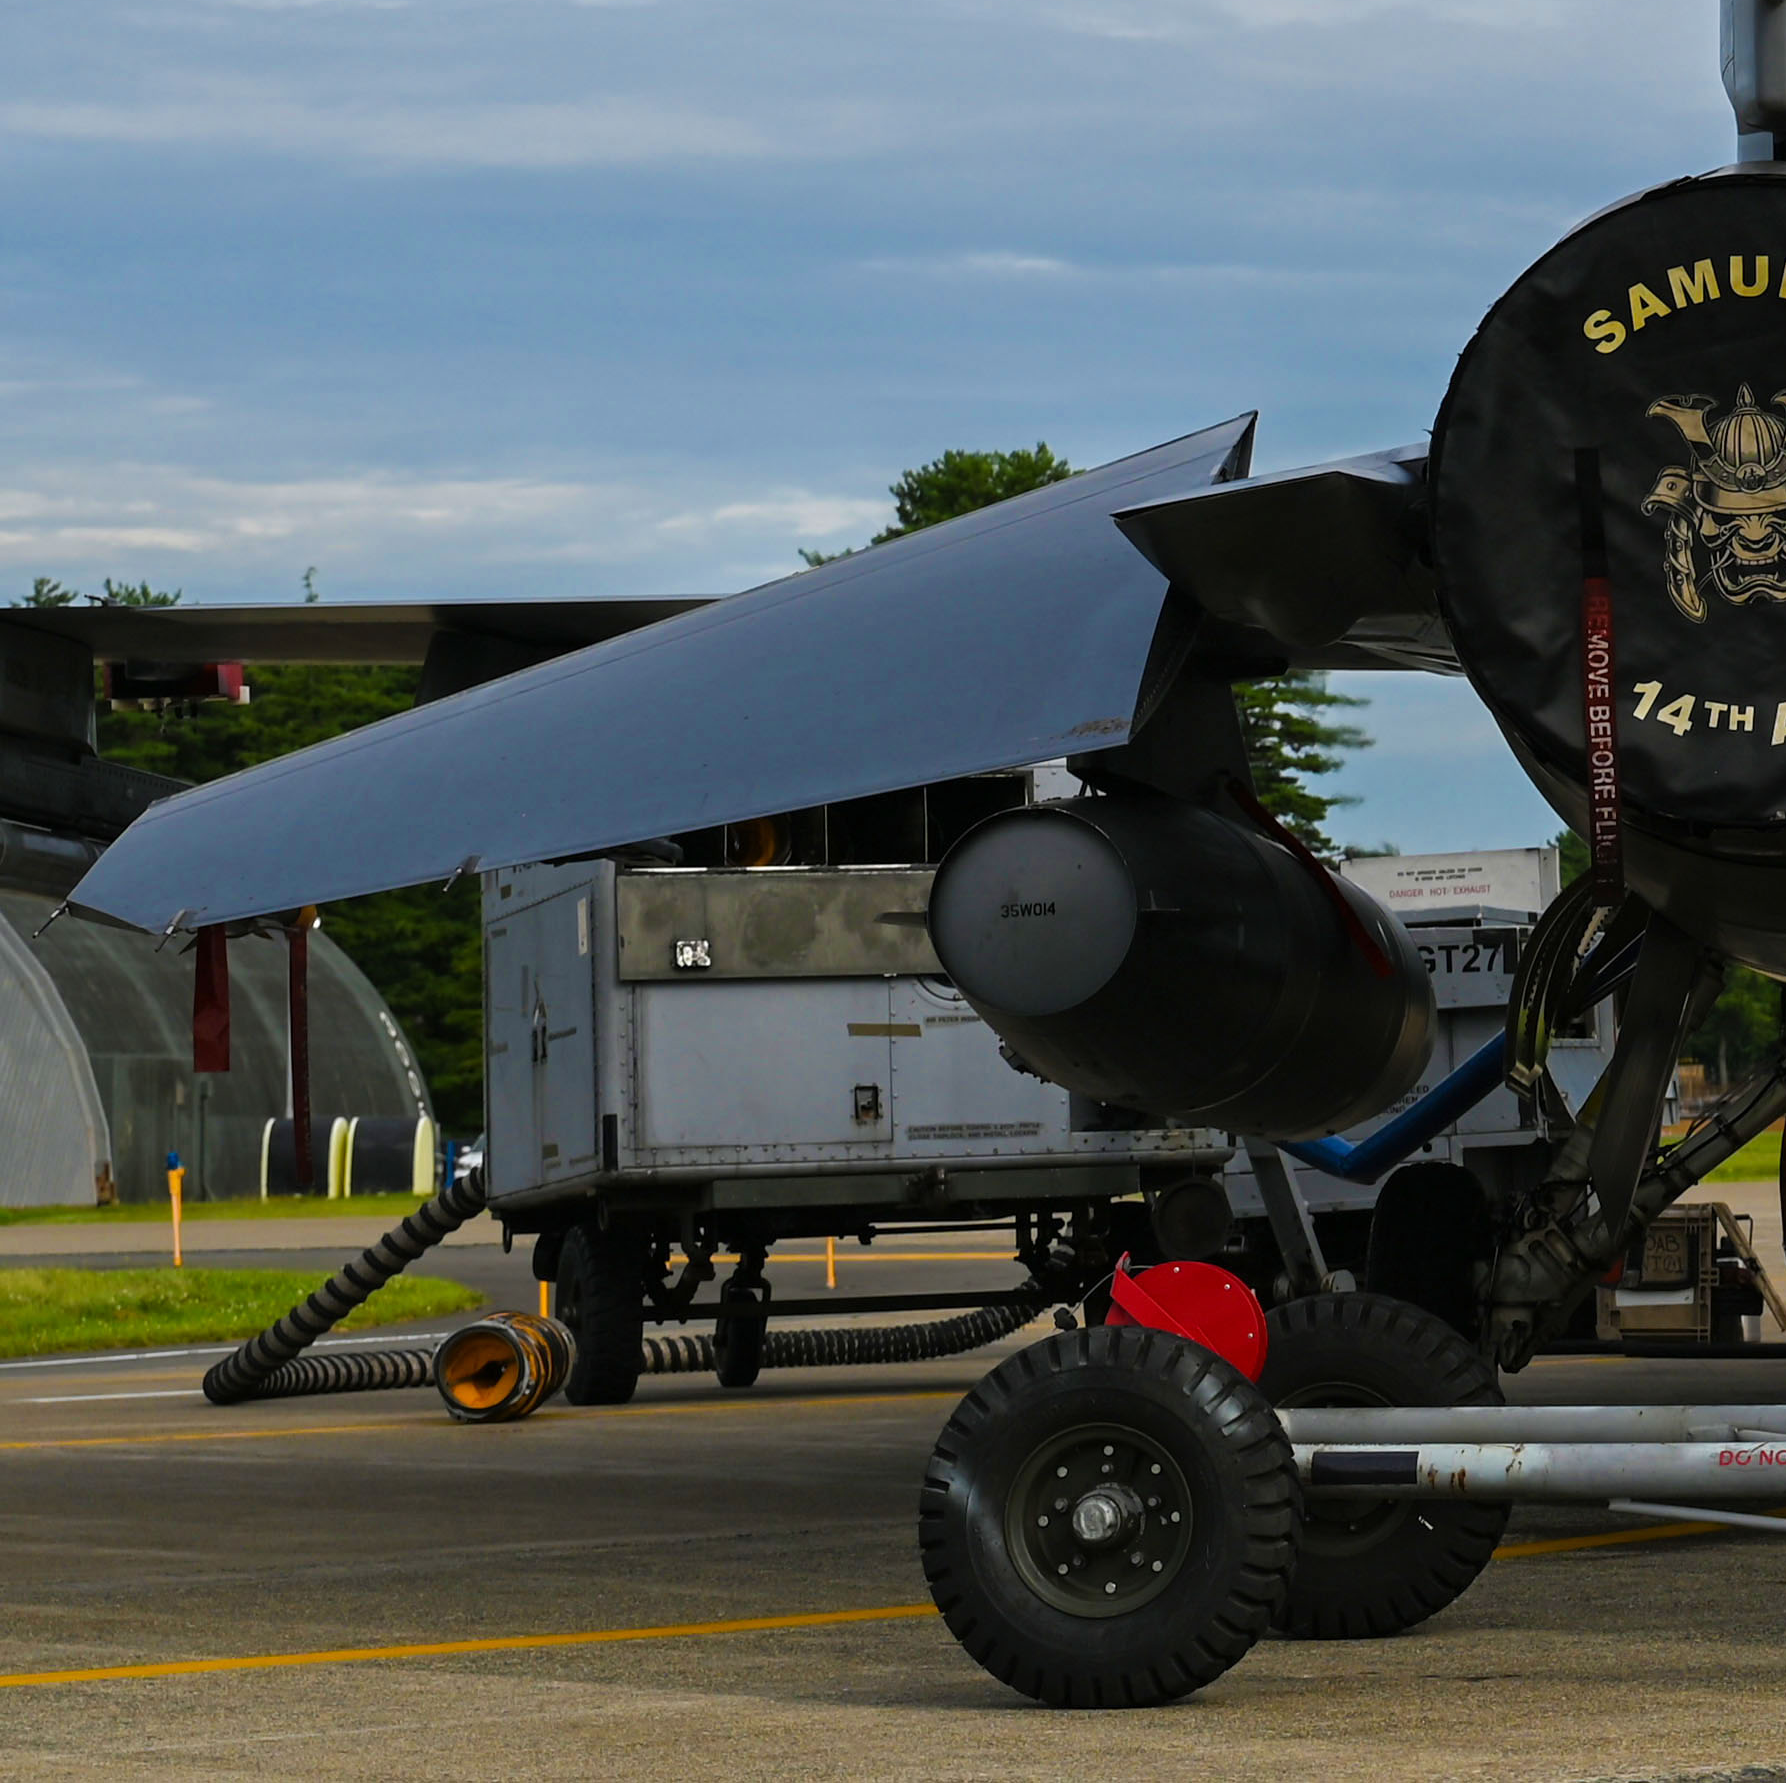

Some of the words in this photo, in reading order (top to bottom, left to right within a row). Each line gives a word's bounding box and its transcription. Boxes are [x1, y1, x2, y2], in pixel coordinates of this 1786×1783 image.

[1633, 680, 1754, 736] 14TH
[1589, 706, 1615, 800] BEFORE
[1389, 888, 1424, 899] DANGER
[1430, 887, 1447, 897] HOT
[1453, 884, 1490, 895] EXHAUST
[1719, 1450, 1752, 1466] DO
